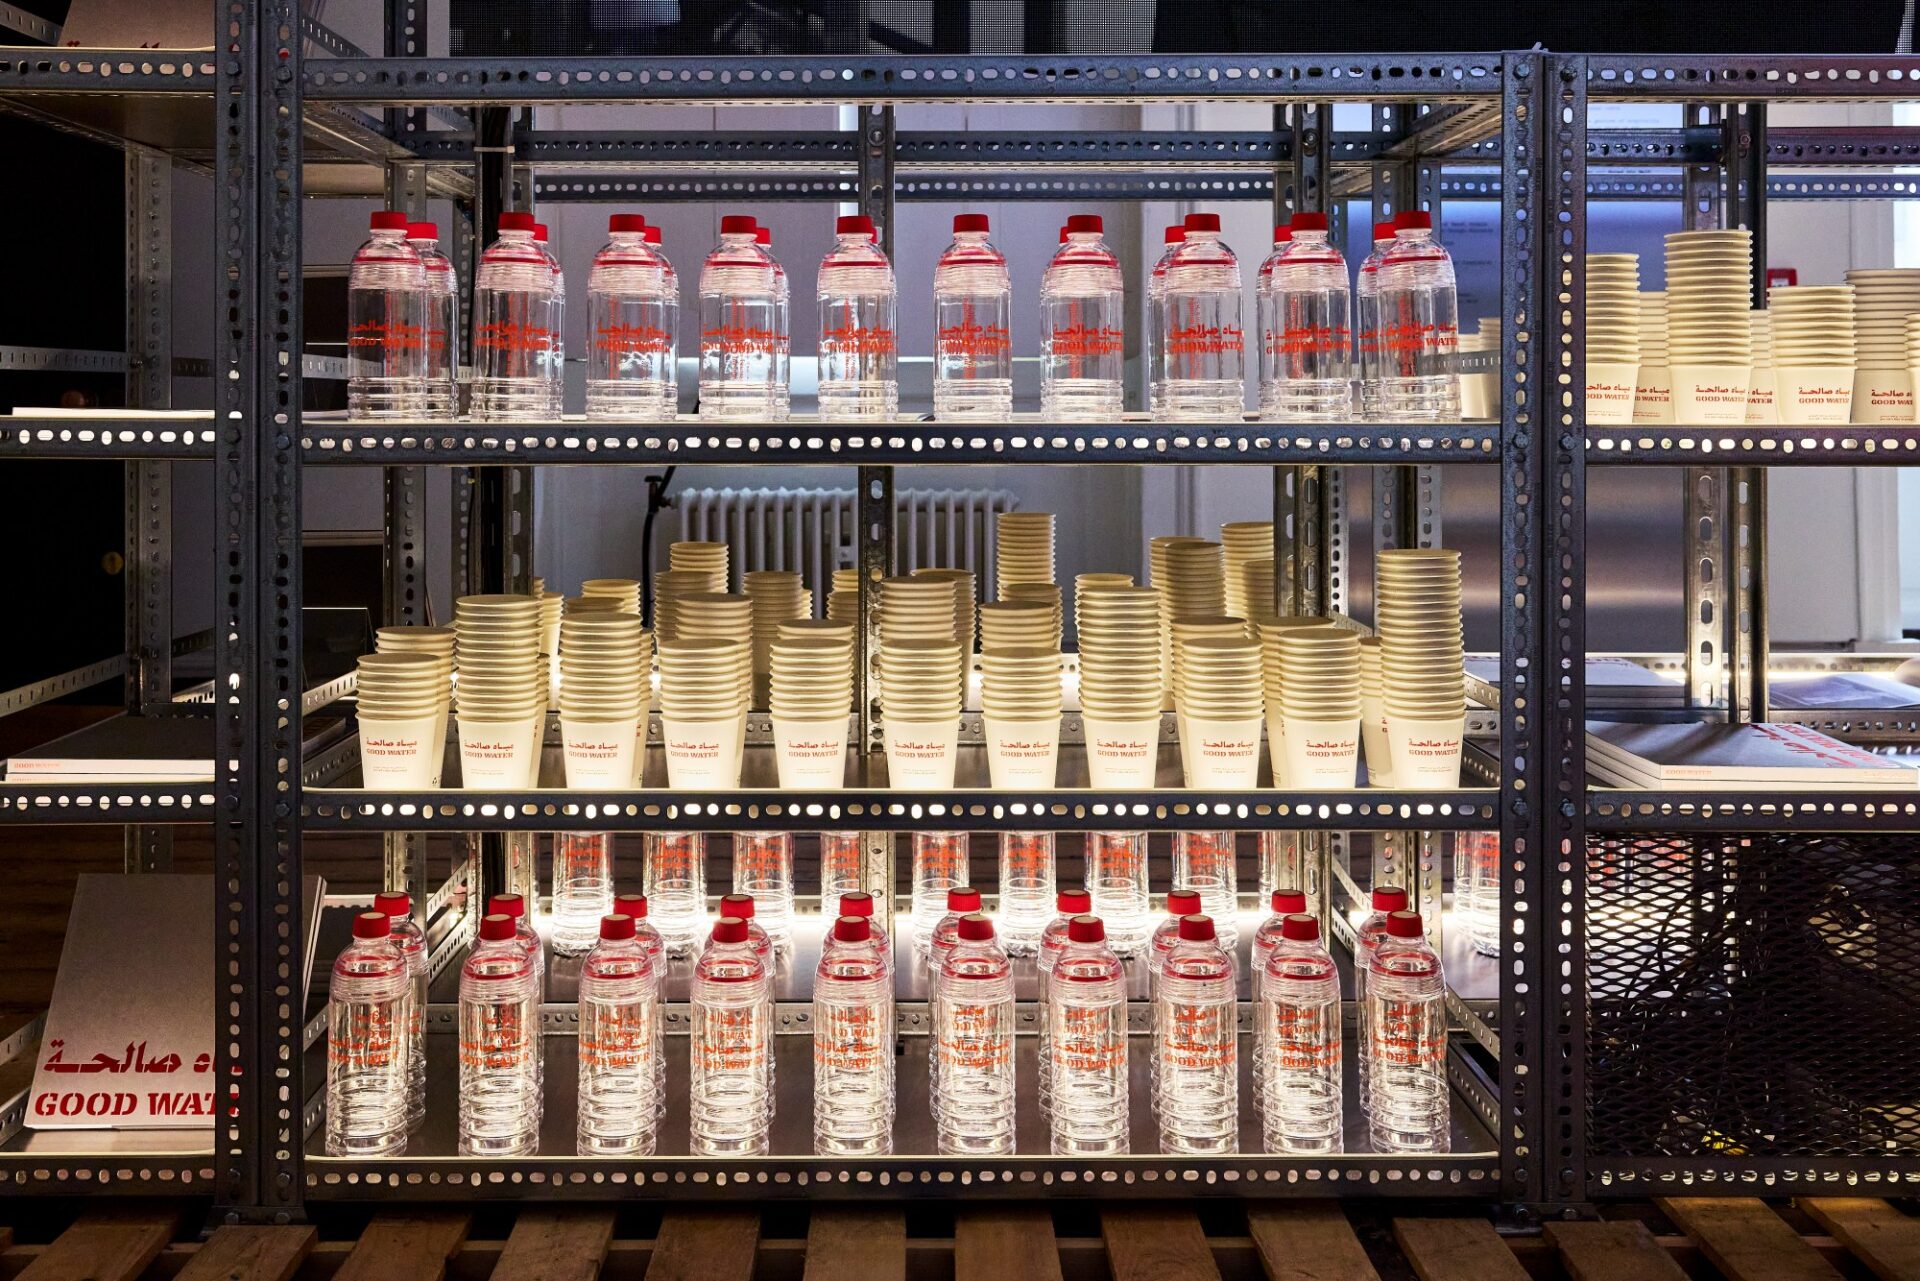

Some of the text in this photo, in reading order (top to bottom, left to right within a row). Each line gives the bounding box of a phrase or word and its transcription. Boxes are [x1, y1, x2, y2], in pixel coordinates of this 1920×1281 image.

[1024, 750, 1050, 758] WATER
[1120, 750, 1147, 758] WATER
[44, 1039, 182, 1073] صالحة
[34, 1092, 216, 1116] GOOD WAT
